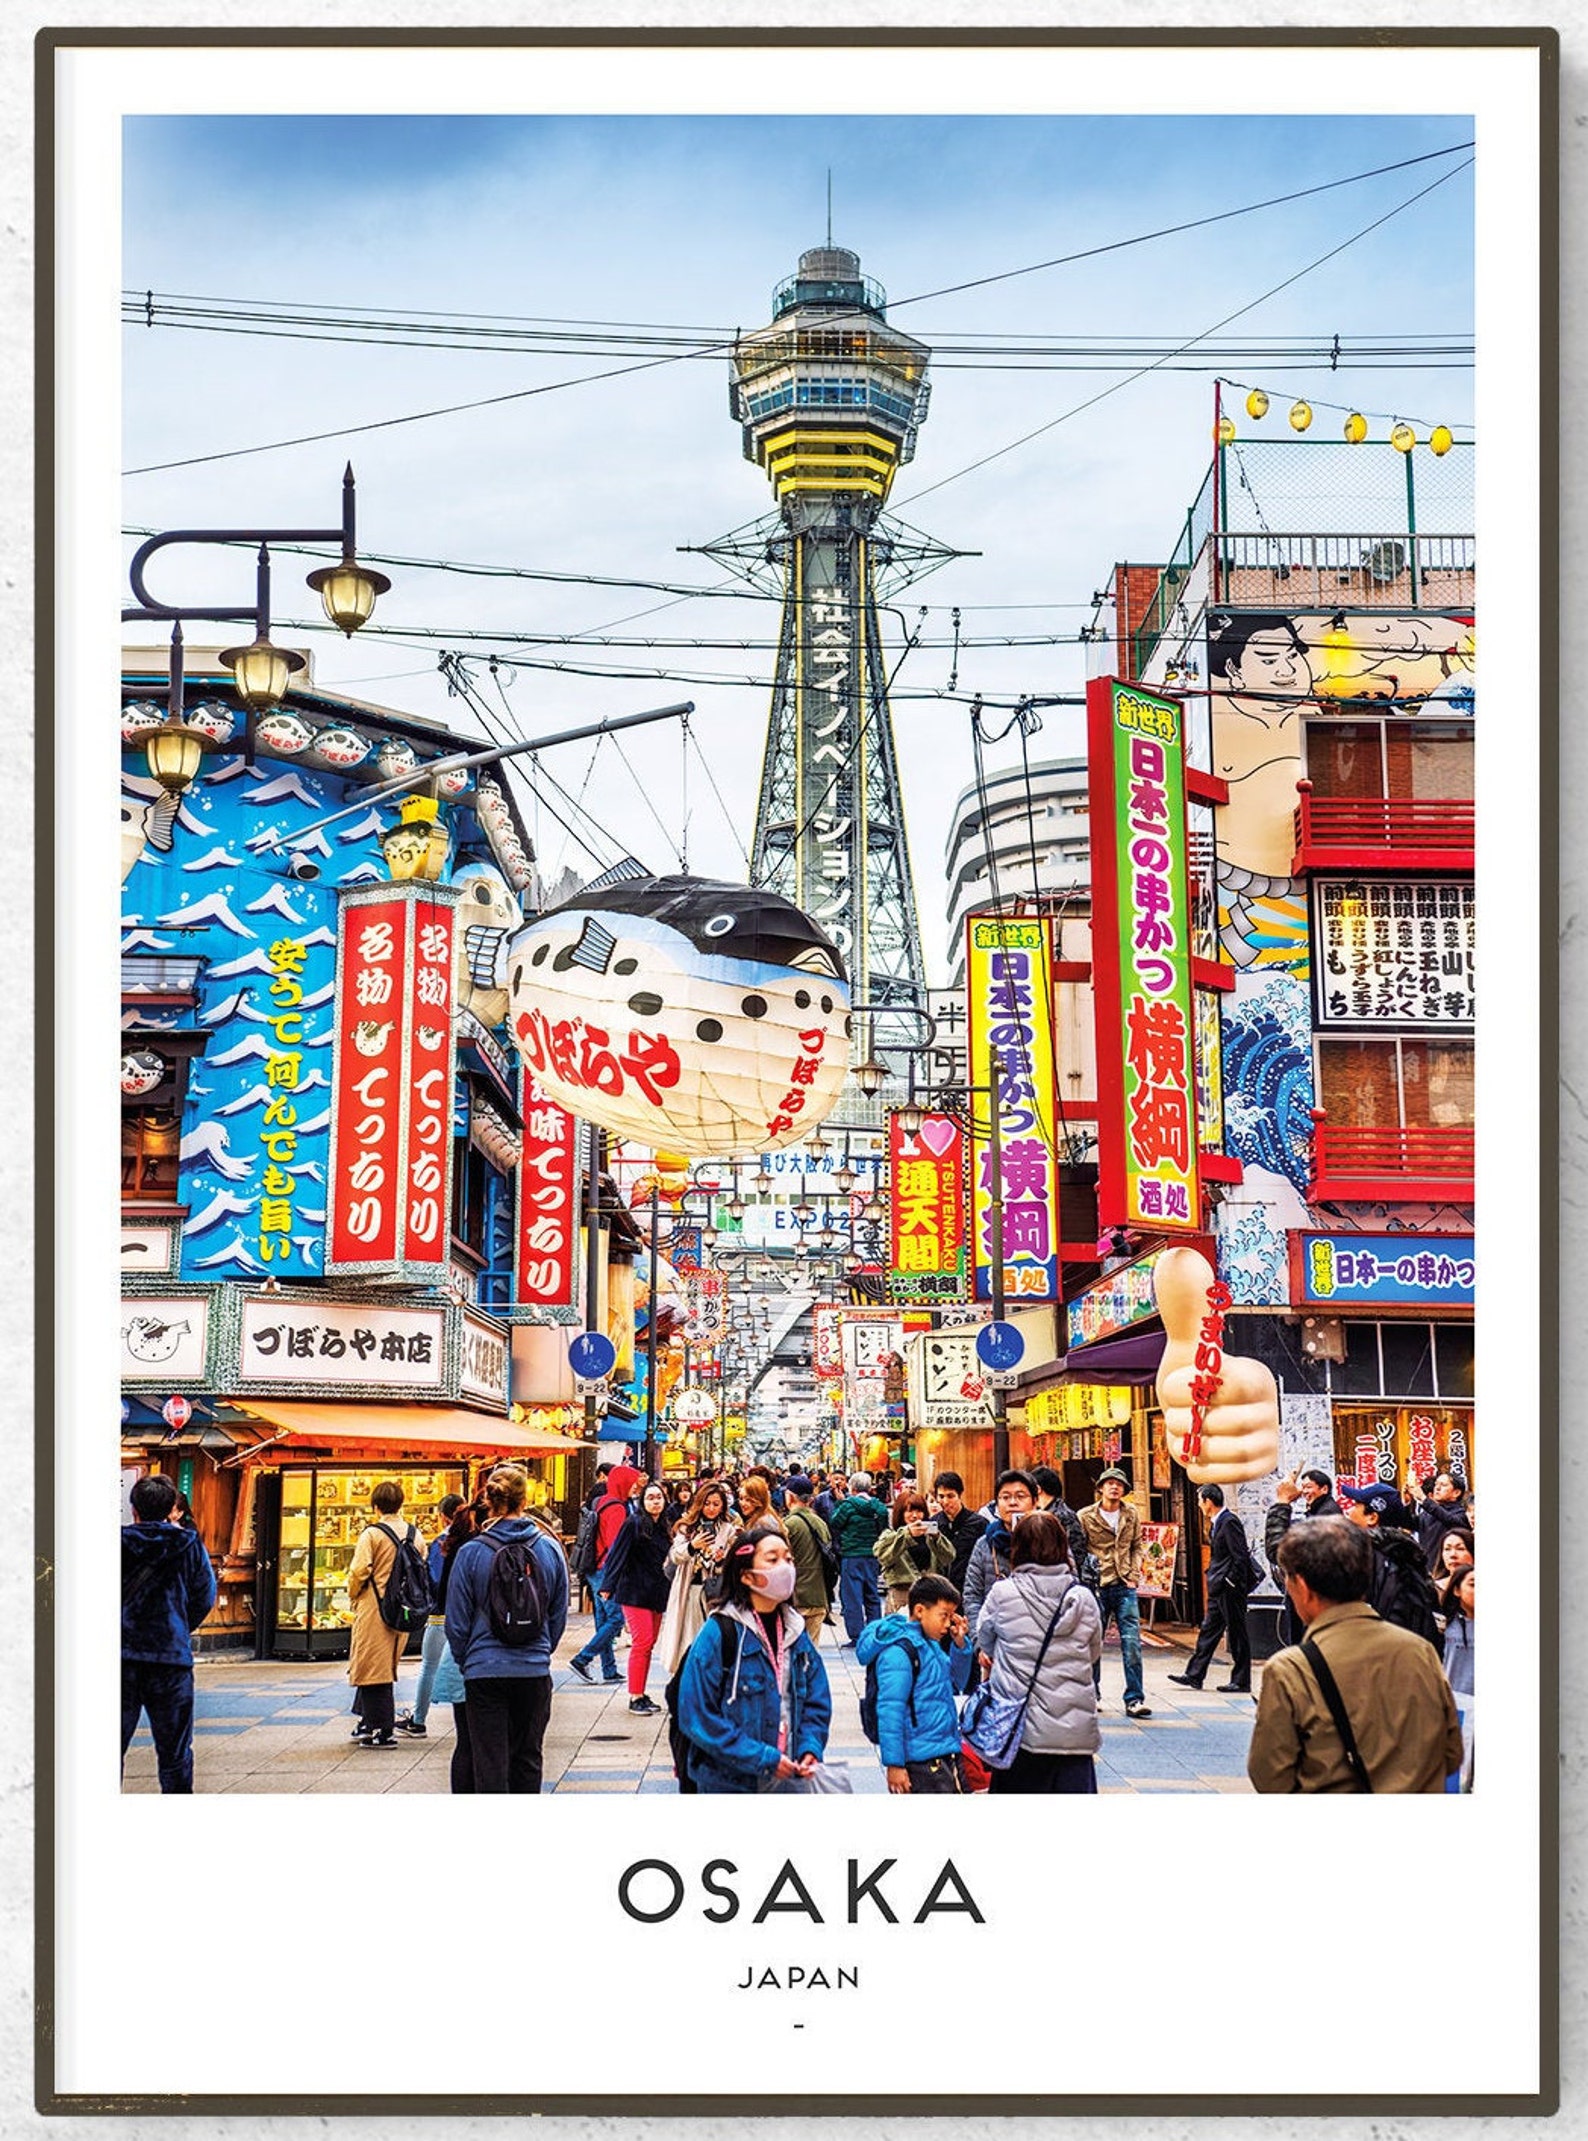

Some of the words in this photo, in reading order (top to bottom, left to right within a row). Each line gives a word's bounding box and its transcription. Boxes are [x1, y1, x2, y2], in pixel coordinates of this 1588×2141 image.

[1116, 695, 1177, 742] 新世界
[1130, 738, 1174, 996] 日本一の串かつ
[357, 922, 394, 1006] 名物
[417, 923, 448, 1007] 名物
[1327, 950, 1348, 1016] もち
[1350, 950, 1373, 1017] うずら玉子
[1373, 950, 1396, 1016] 紅しょうが
[1395, 951, 1417, 1017] にんにく
[1419, 951, 1441, 1017] 玉ねぎ
[1442, 951, 1465, 1017] 山芋
[516, 1008, 680, 1106] づぼらや
[988, 953, 1036, 1134] 日本一の串かつ
[259, 937, 308, 1262] 安うて何んでも旨い
[766, 1027, 828, 1136] づぼらや
[1128, 997, 1189, 1174] 横綱
[348, 1067, 389, 1242] てっちり
[410, 1069, 444, 1242] てっちり
[897, 1160, 939, 1272] 通天閣
[942, 1160, 956, 1271] TSUTENKAKU
[1140, 1180, 1189, 1219] 酒処
[1336, 1253, 1474, 1285] 日本一の串かつ
[253, 1324, 432, 1364] づぼらや本店
[577, 1383, 606, 1393] 9-22
[1378, 1424, 1395, 1479] ソースの
[618, 1858, 986, 1923] OSAKA
[738, 1966, 858, 1989] JAPAN
